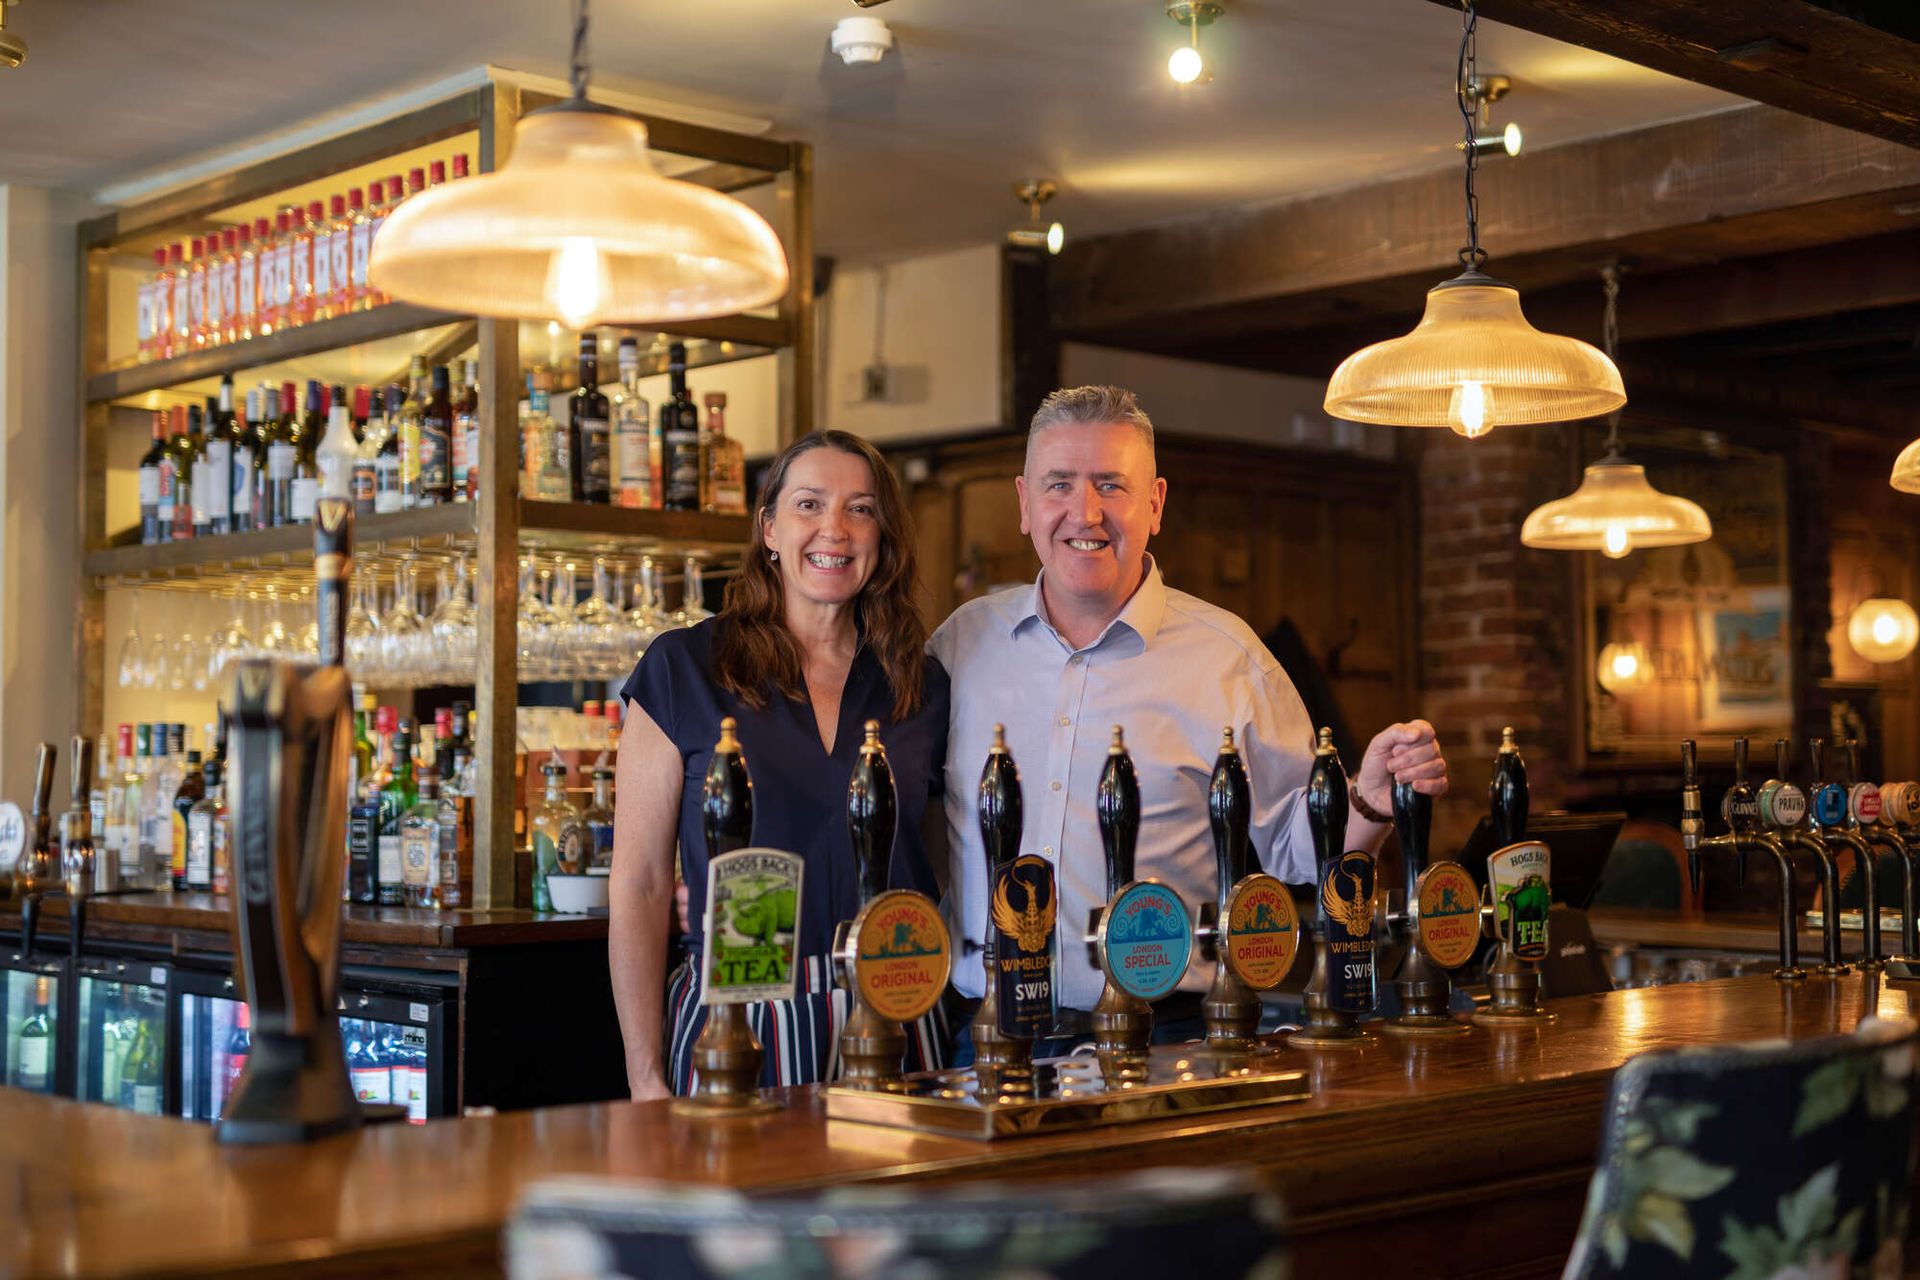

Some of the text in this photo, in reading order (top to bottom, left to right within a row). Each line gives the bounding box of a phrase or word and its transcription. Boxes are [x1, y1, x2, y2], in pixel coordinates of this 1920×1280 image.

[1732, 802, 1758, 815] GUINNE
[1510, 852, 1534, 867] HOGS
[1125, 895, 1172, 917] YOUNG'S
[1244, 890, 1282, 912] YOUNG'S
[877, 908, 928, 930] YOUNG'S
[1248, 936, 1274, 946] LONDON
[1429, 927, 1470, 941] ORIGINAL
[1132, 944, 1163, 954] LONDON
[1238, 946, 1285, 960] ORIGINAL
[1125, 953, 1171, 969] SPECIAL
[723, 959, 782, 982] TEA
[1344, 962, 1373, 979] SW19
[872, 970, 933, 989] ORIGINAL
[1015, 981, 1049, 1001] SW19
[404, 1033, 424, 1044] rhino
